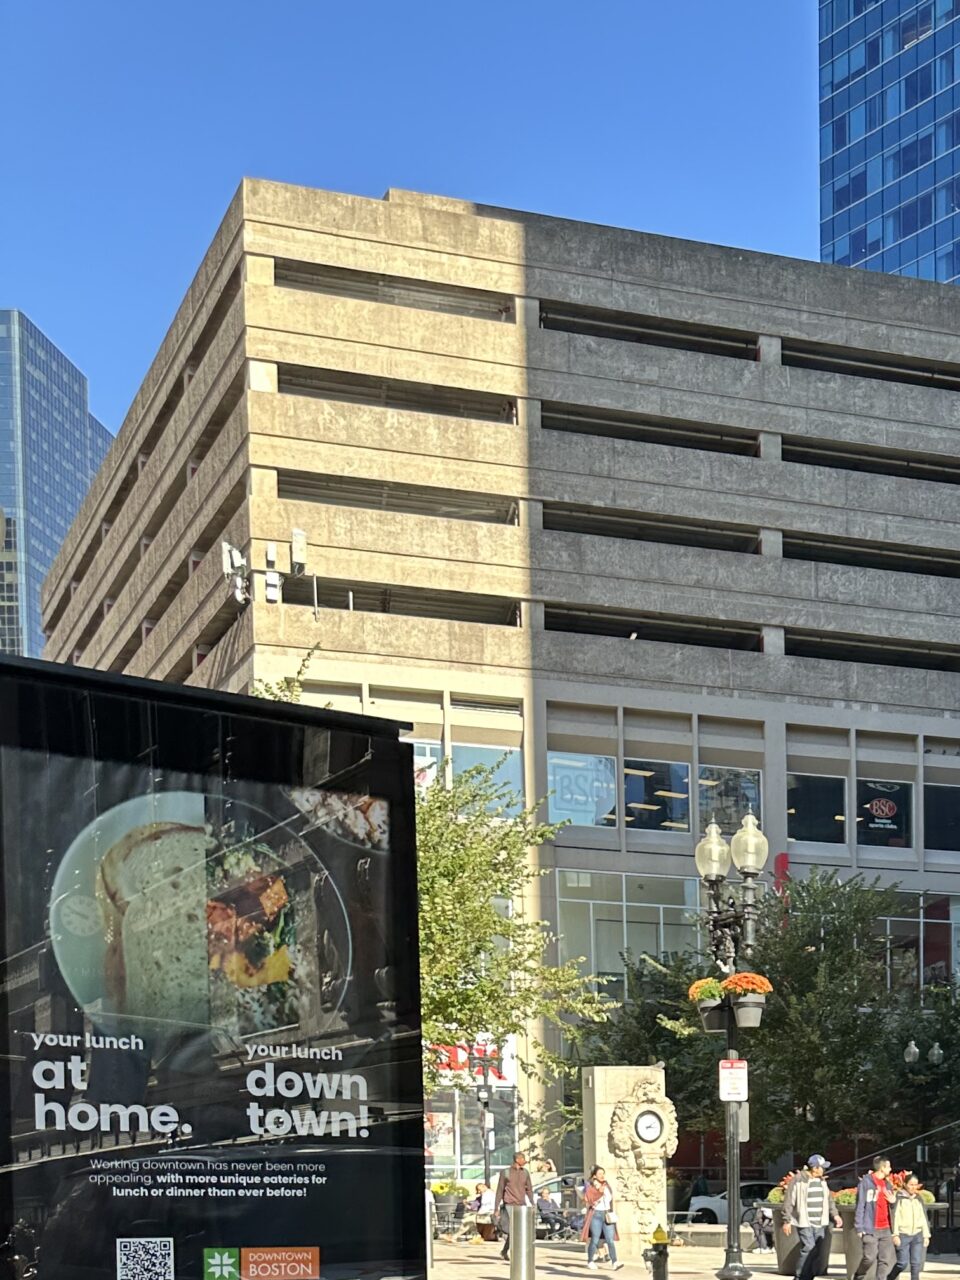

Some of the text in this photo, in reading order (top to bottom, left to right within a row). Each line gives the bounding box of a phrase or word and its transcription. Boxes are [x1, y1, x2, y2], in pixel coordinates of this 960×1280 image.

[873, 800, 896, 817] BSC
[30, 1032, 144, 1050] your lunch
[245, 1043, 343, 1061] your lunch
[32, 1055, 88, 1090] at
[246, 1062, 368, 1100] down
[34, 1093, 193, 1134] home.
[246, 1102, 370, 1138] town!
[90, 1159, 326, 1172] Working downtown has never been more
[88, 1173, 328, 1186] appealing, with more unique eateries for
[112, 1186, 307, 1197] lunch or dinner than ever before!
[249, 1252, 312, 1261] DOWNTOWN
[249, 1262, 312, 1276] BOSTON
